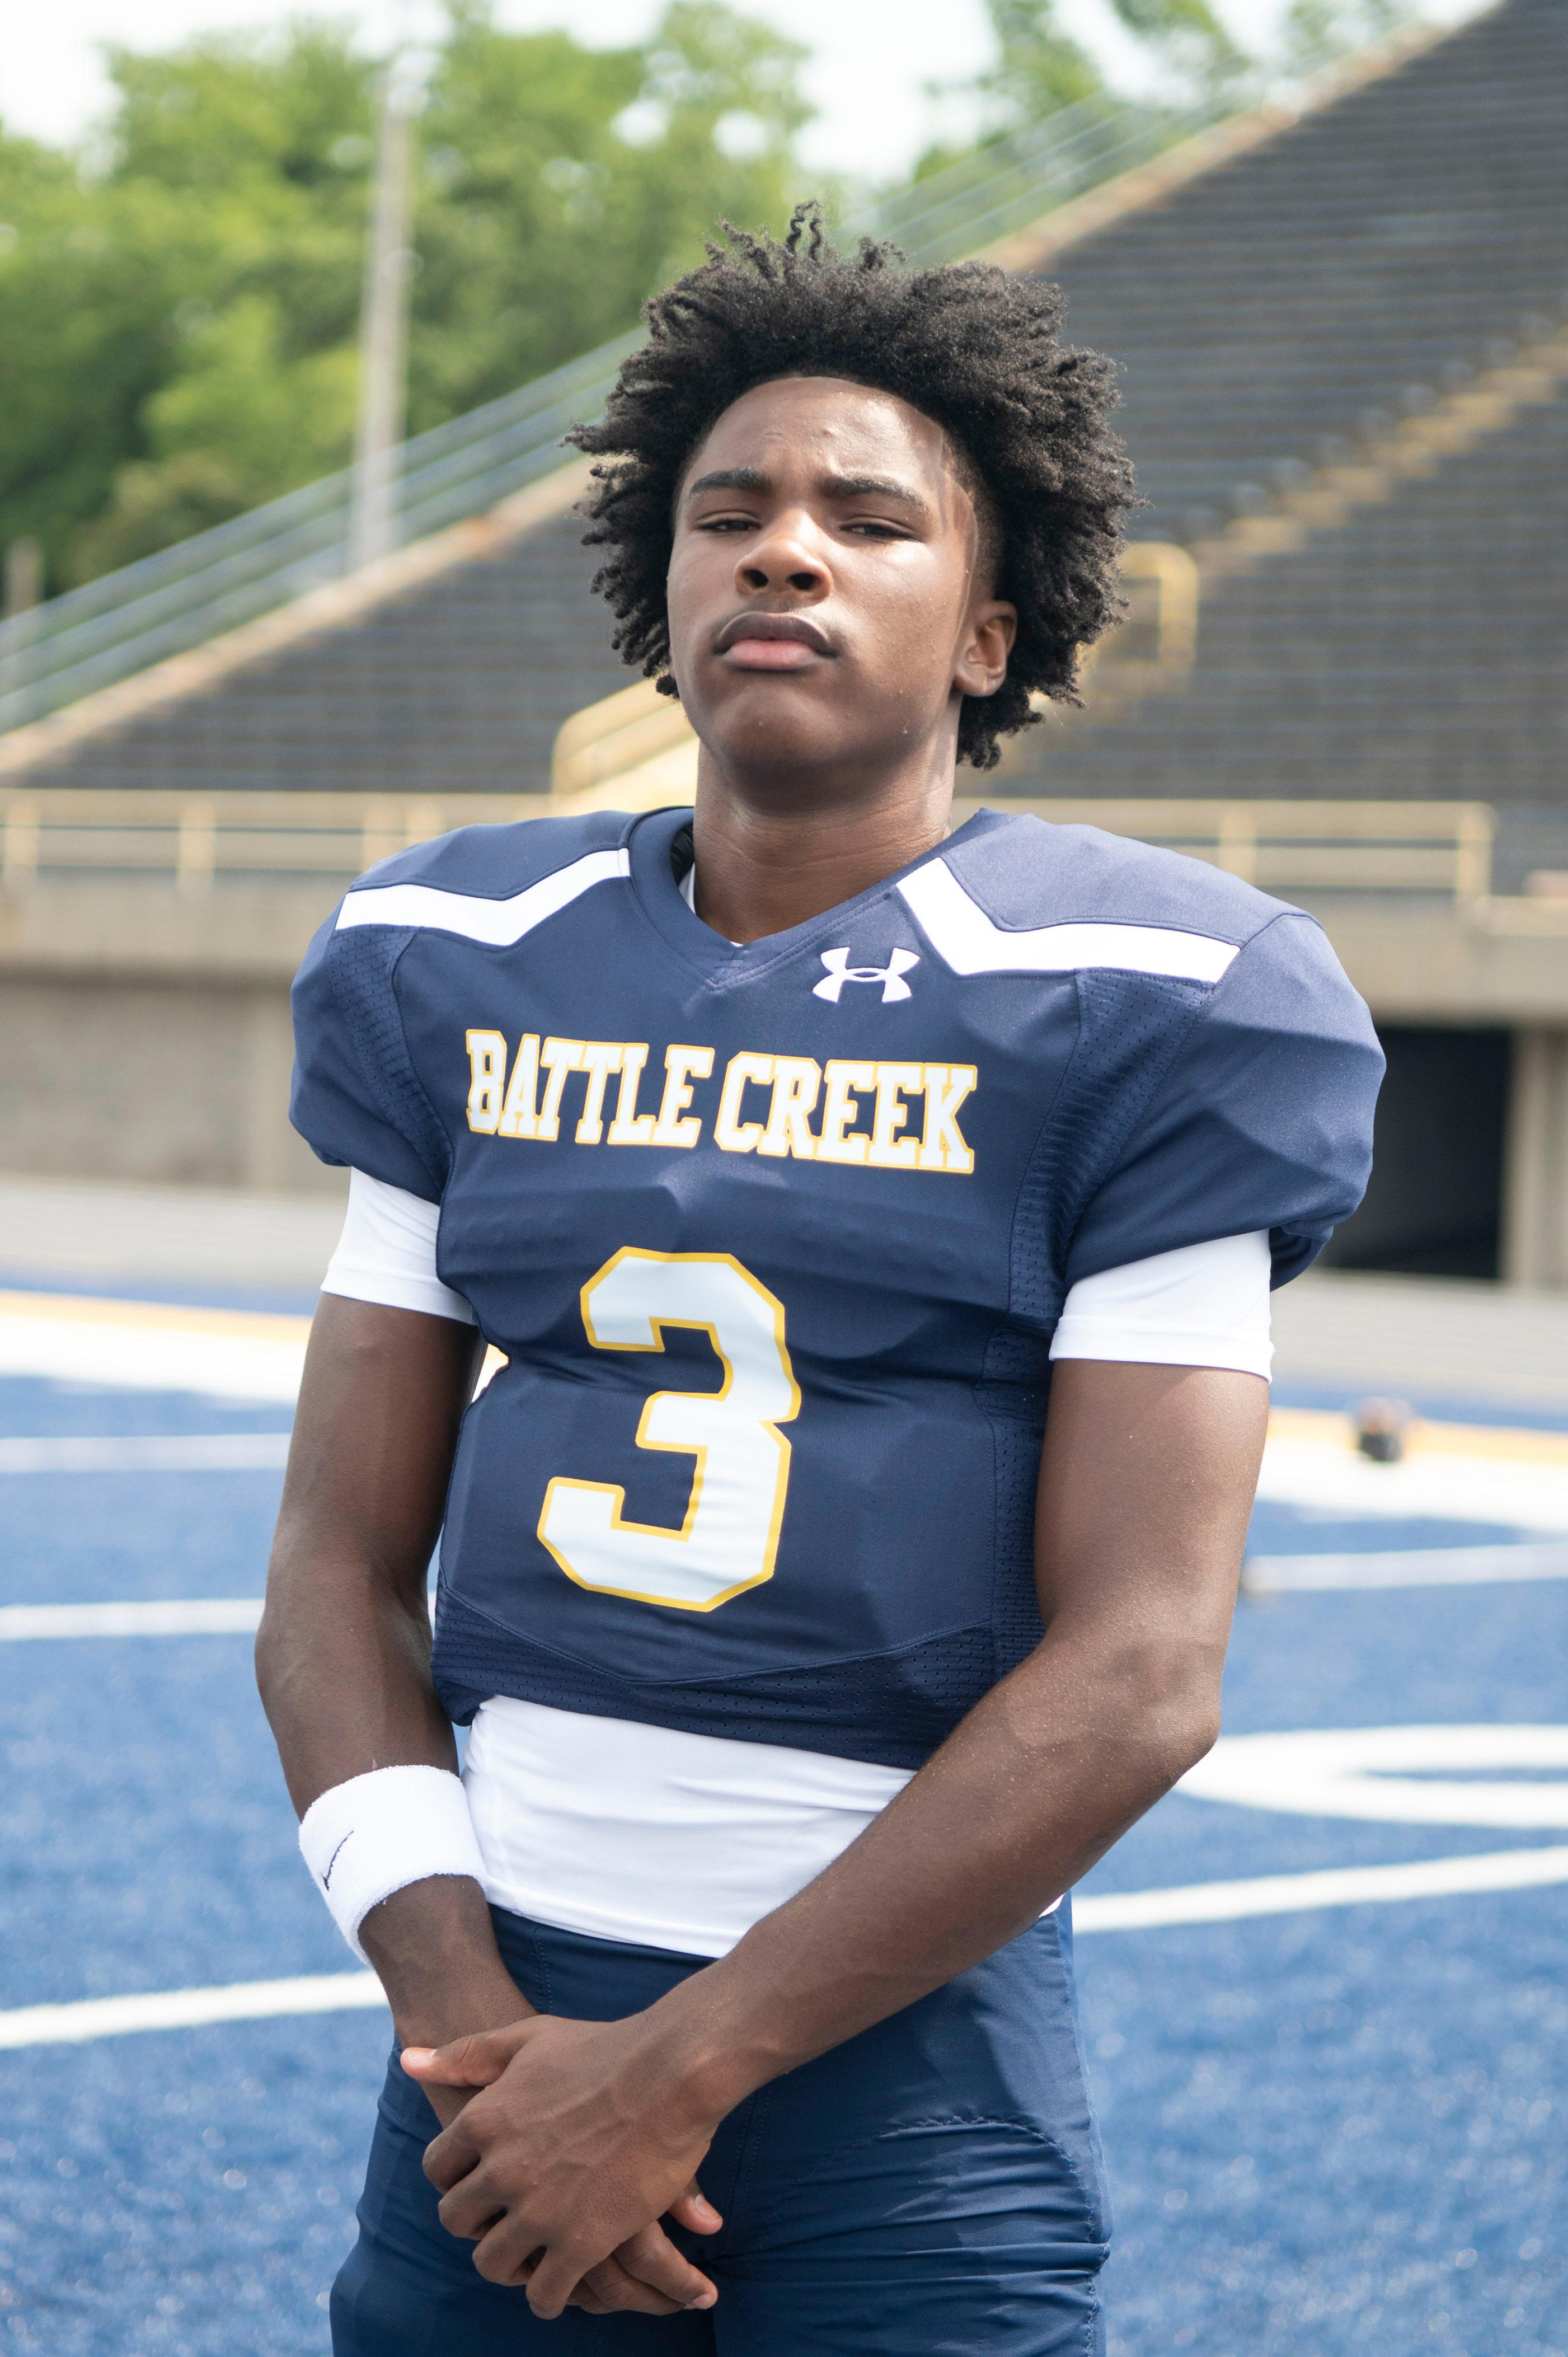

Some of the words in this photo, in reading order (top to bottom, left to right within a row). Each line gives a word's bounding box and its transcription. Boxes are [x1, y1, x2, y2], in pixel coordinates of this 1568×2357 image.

[466, 1029, 715, 1148] BATTLE
[714, 1051, 977, 1174] CREEK
[537, 1246, 801, 1612] 3
